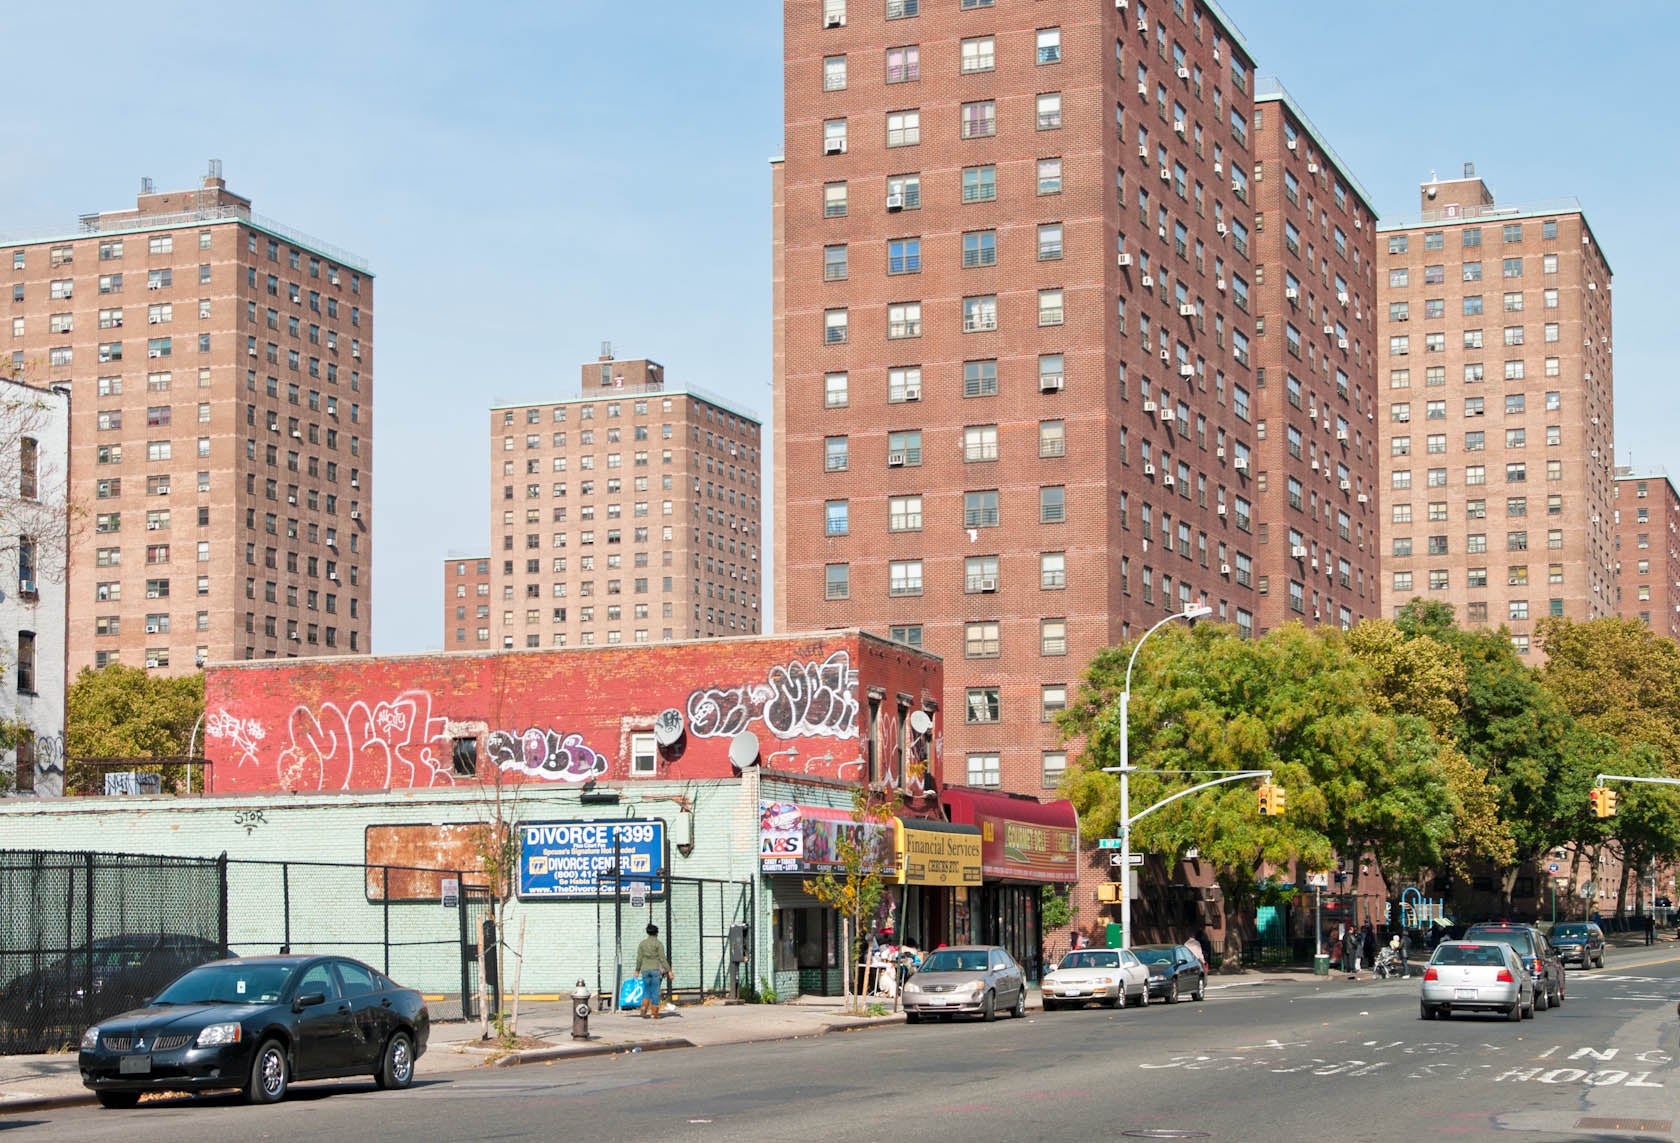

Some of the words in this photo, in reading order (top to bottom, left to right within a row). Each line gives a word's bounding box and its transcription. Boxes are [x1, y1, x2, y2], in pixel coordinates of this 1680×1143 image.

[527, 826, 608, 845] DIVORCE
[612, 825, 654, 843] $399
[762, 836, 799, 853] N&S
[907, 833, 945, 855] Financial
[947, 838, 980, 857] Services
[548, 856, 590, 871] DIVORCE
[553, 870, 579, 879] (800)
